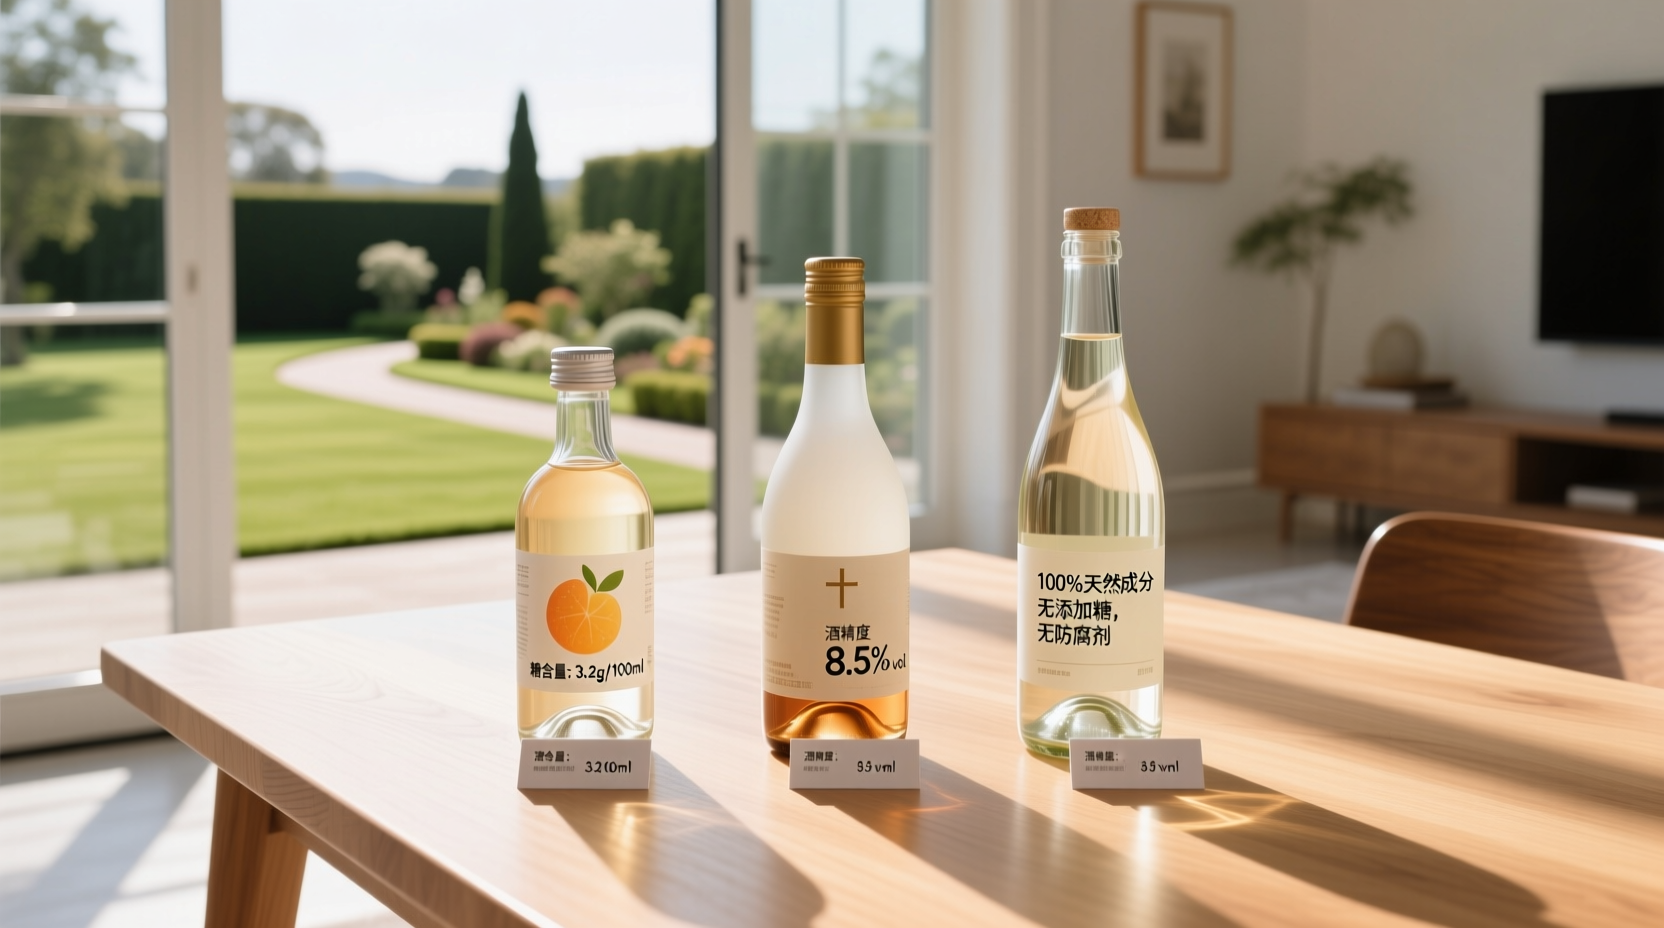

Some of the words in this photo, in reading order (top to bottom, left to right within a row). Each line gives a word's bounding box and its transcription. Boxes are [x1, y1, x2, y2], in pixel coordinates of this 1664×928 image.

[1037, 571, 1154, 595] 100%天然成分
[825, 623, 871, 642] 酒精度
[1037, 622, 1111, 646] 无防腐剂
[575, 657, 644, 683] 3.2g/100ml
